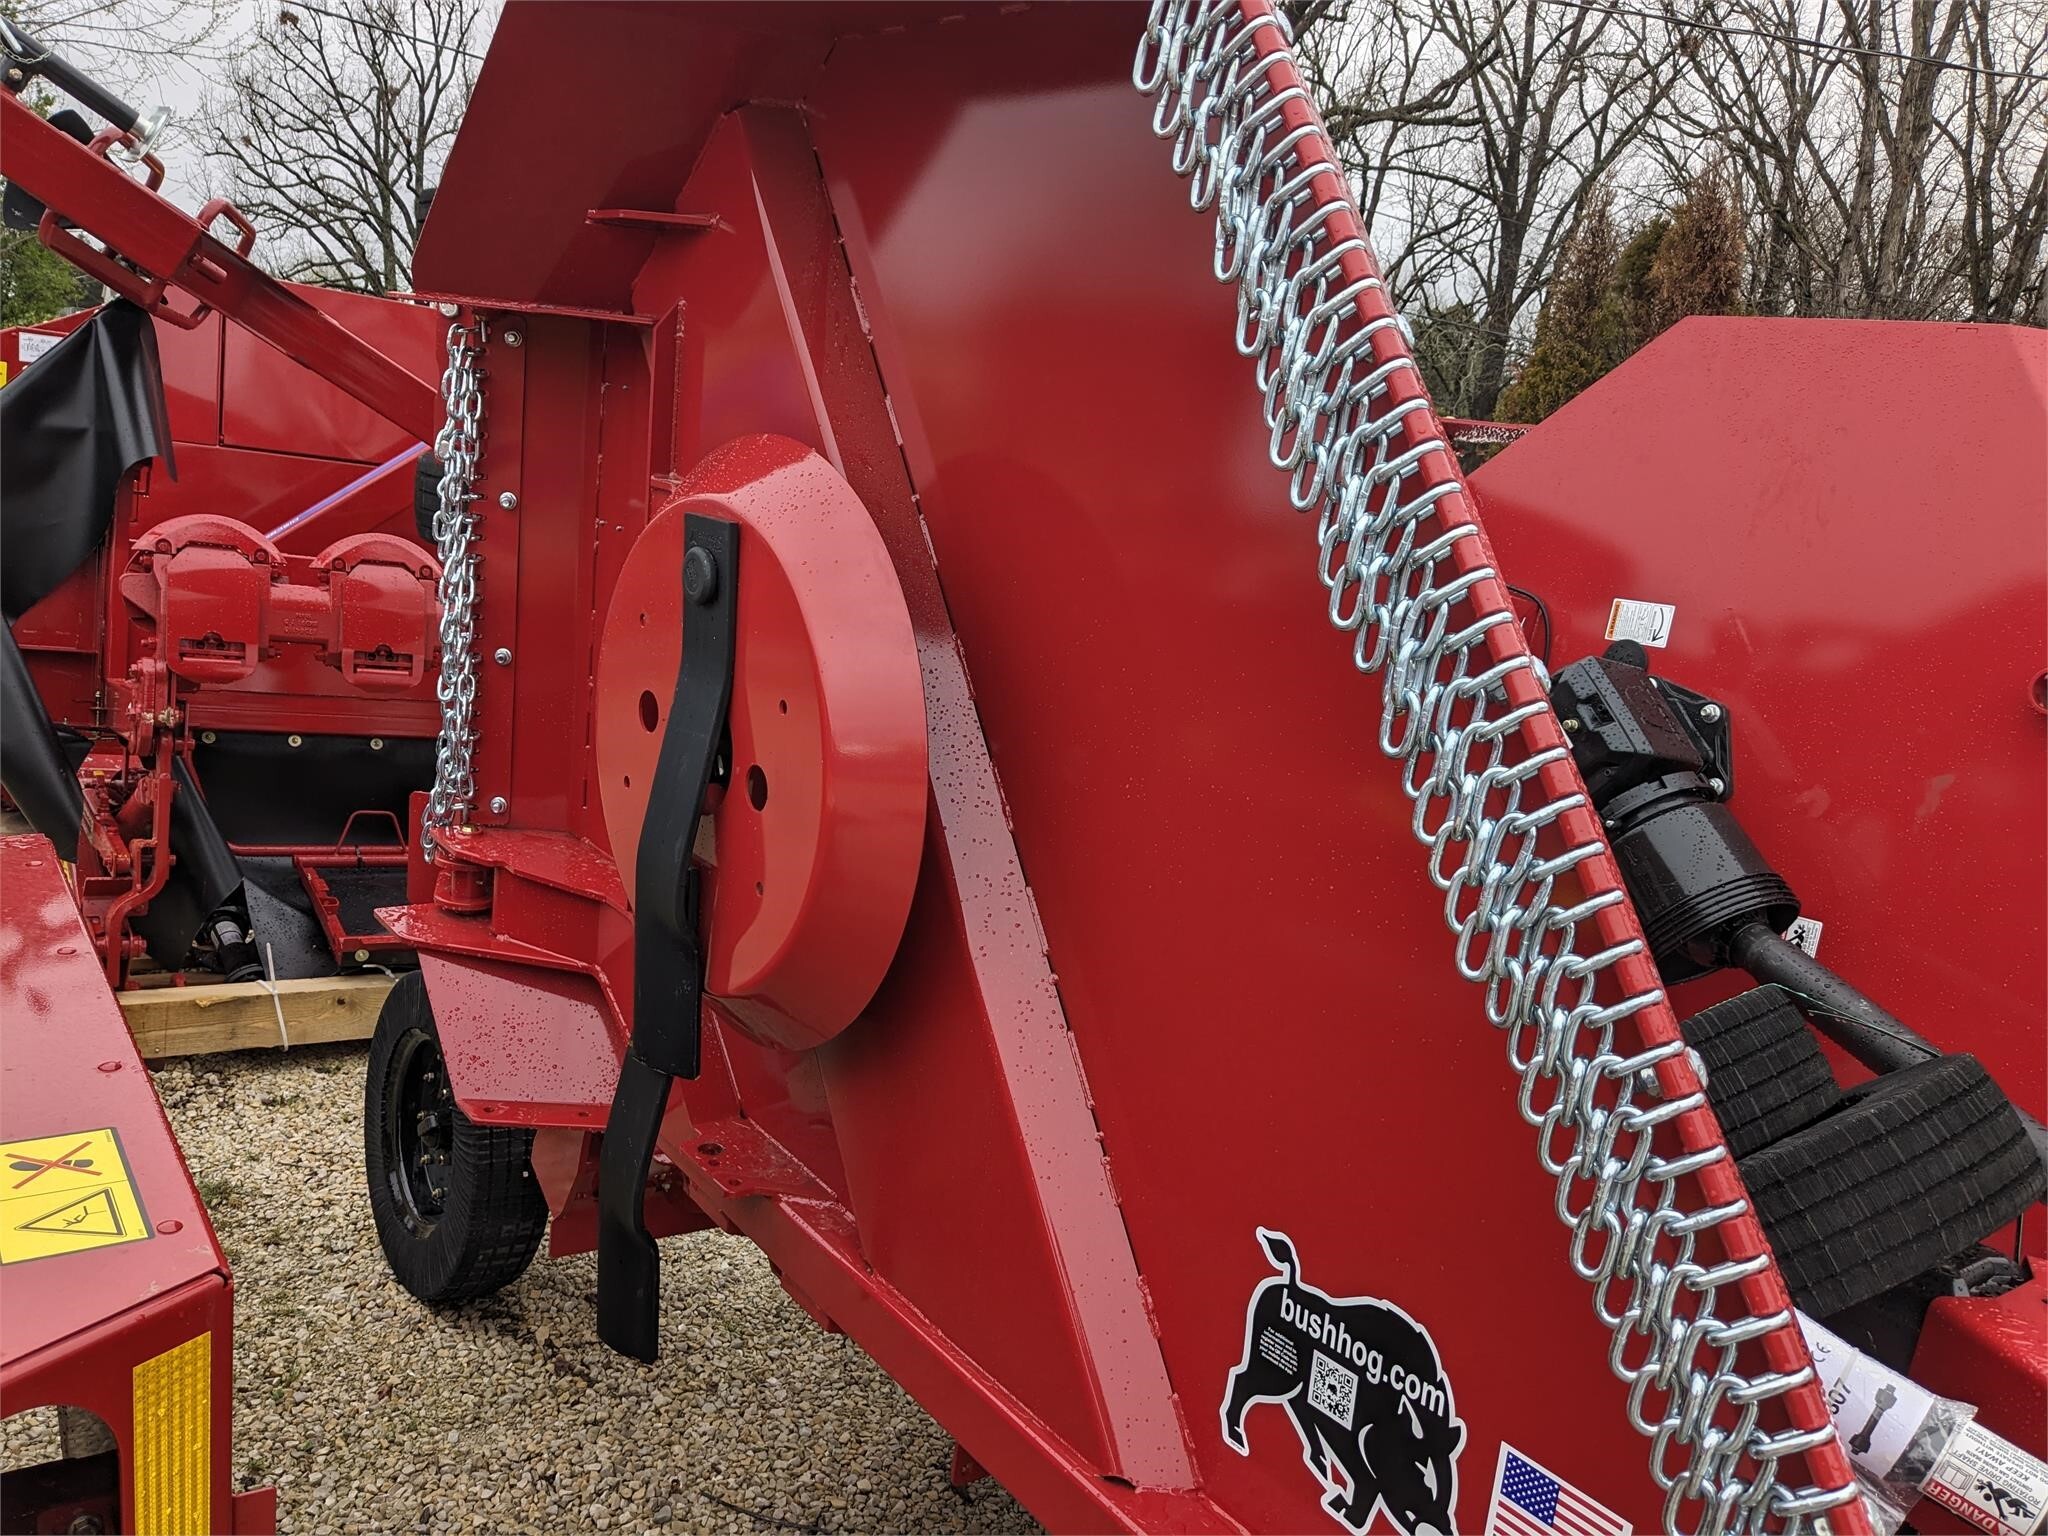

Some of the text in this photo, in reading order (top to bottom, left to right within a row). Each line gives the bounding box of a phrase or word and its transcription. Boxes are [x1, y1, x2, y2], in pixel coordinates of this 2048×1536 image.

[1280, 1288, 1445, 1417] bushhog.com
[1952, 1448, 1978, 1467] SHAFT
[1974, 1445, 2005, 1467] AWAY!
[1977, 1464, 2001, 1482] DRIVE
[2004, 1463, 2029, 1482] KEEP
[2001, 1478, 2040, 1506] ROTATING
[1926, 1481, 1997, 1531] DANGER
